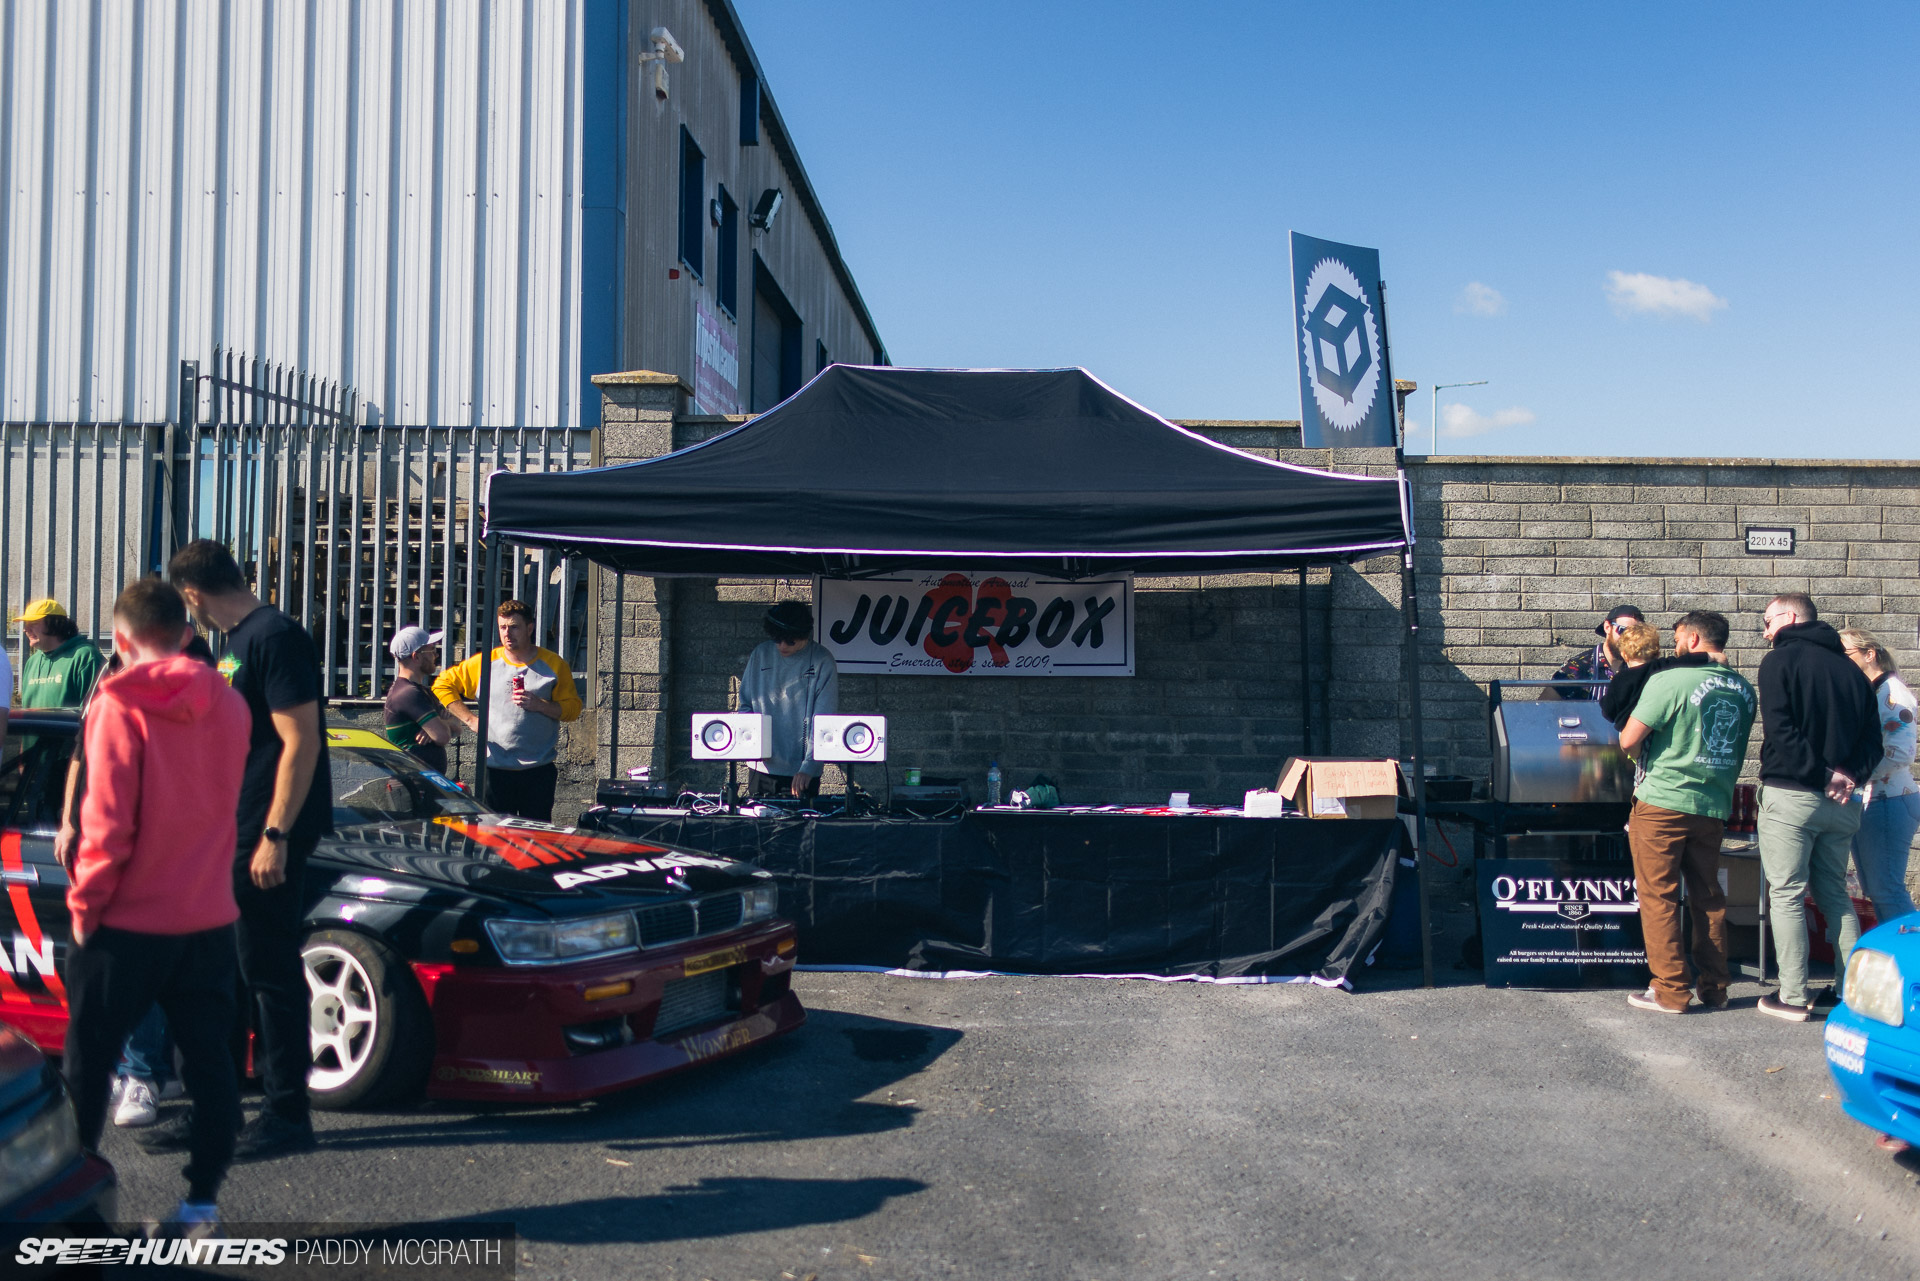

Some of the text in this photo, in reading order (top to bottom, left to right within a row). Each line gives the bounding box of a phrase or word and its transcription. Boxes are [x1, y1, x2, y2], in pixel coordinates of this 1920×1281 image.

[1750, 536, 1788, 547] 220 X 45
[918, 575, 1030, 588] Automotive Arousal
[829, 593, 1116, 649] JUICEBOX
[890, 652, 1050, 671] Emerald style since 2009
[1690, 676, 1725, 707] SLICK
[1584, 923, 1603, 931] Quality
[1574, 957, 1597, 965] prepared
[1624, 957, 1636, 965] shop
